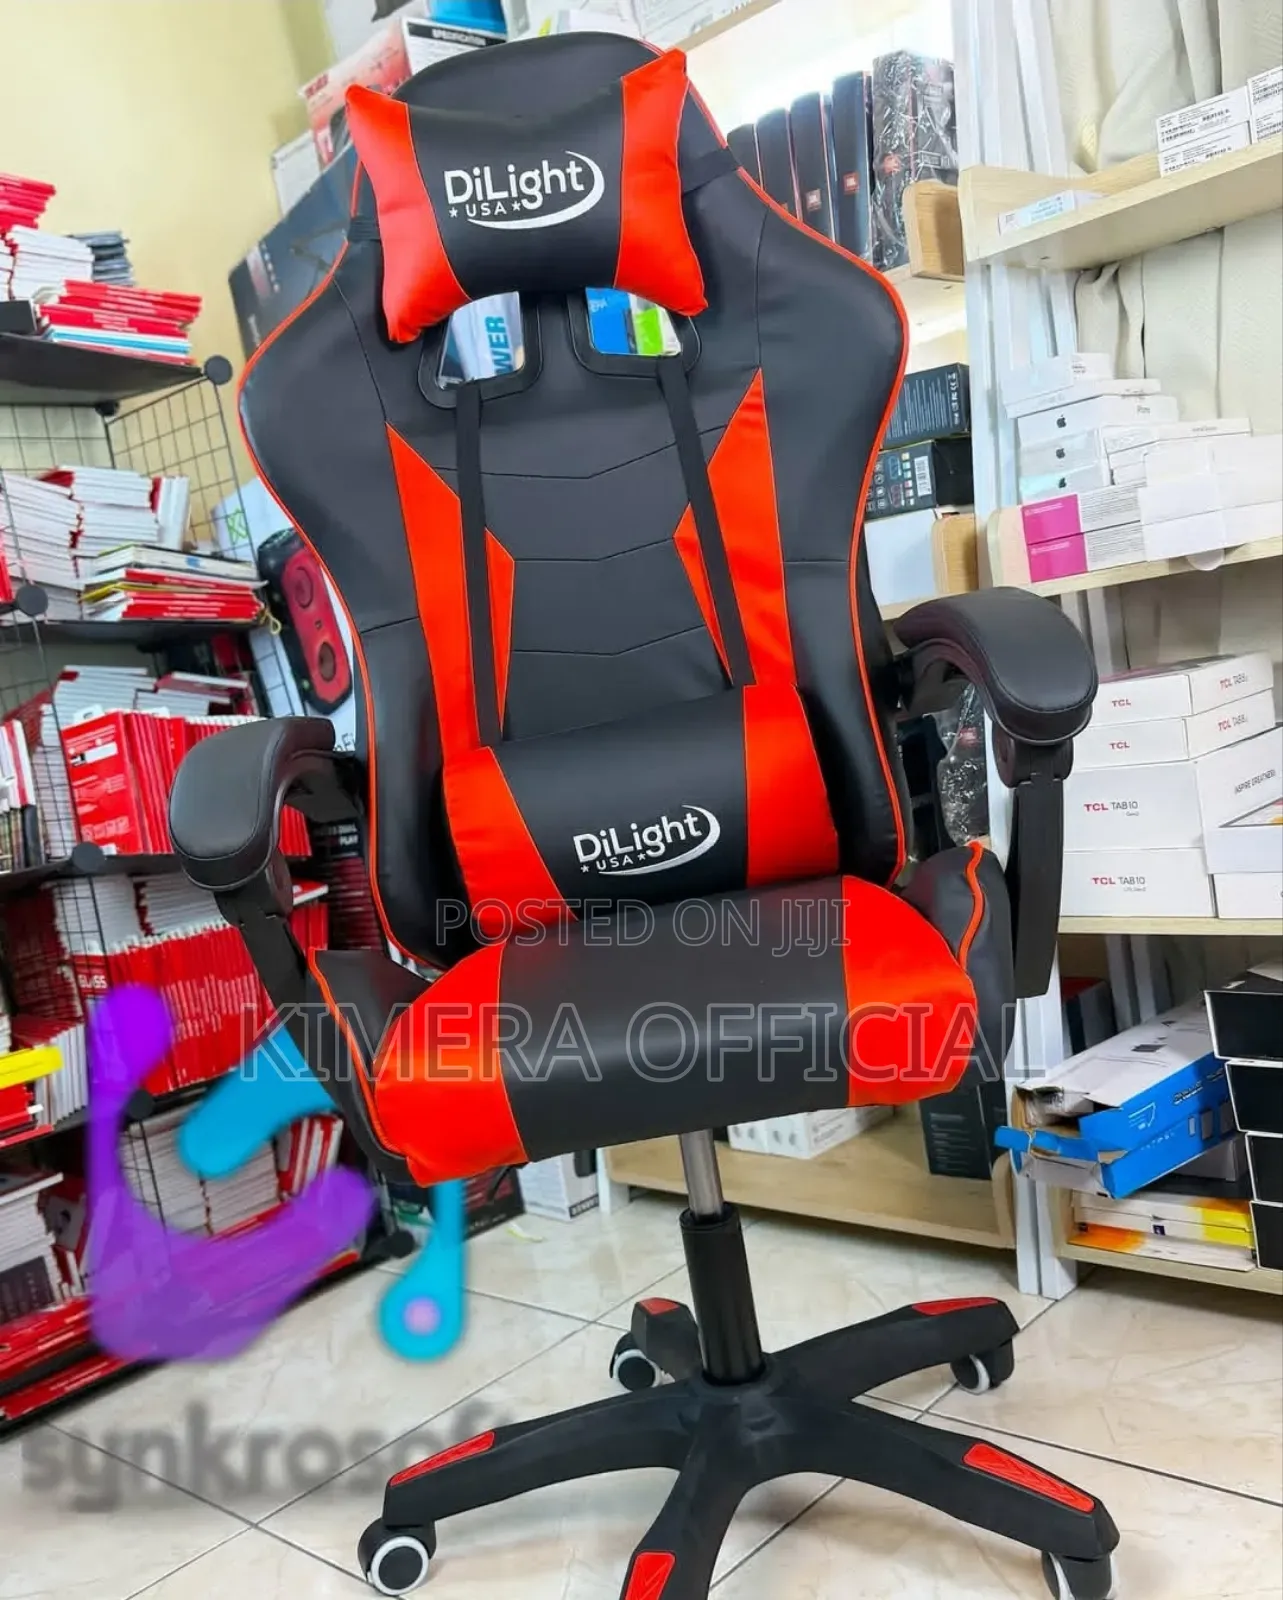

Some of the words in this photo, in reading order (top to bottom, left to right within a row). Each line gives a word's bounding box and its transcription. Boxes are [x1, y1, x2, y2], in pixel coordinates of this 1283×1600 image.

[444, 160, 585, 210] DiLight
[465, 201, 507, 217] USA
[1112, 699, 1132, 708] TCL
[1109, 740, 1130, 750] TCL
[1084, 803, 1109, 812] TCL
[573, 813, 702, 858] DiLight
[595, 855, 634, 871] USA
[1092, 877, 1116, 885] TCL
